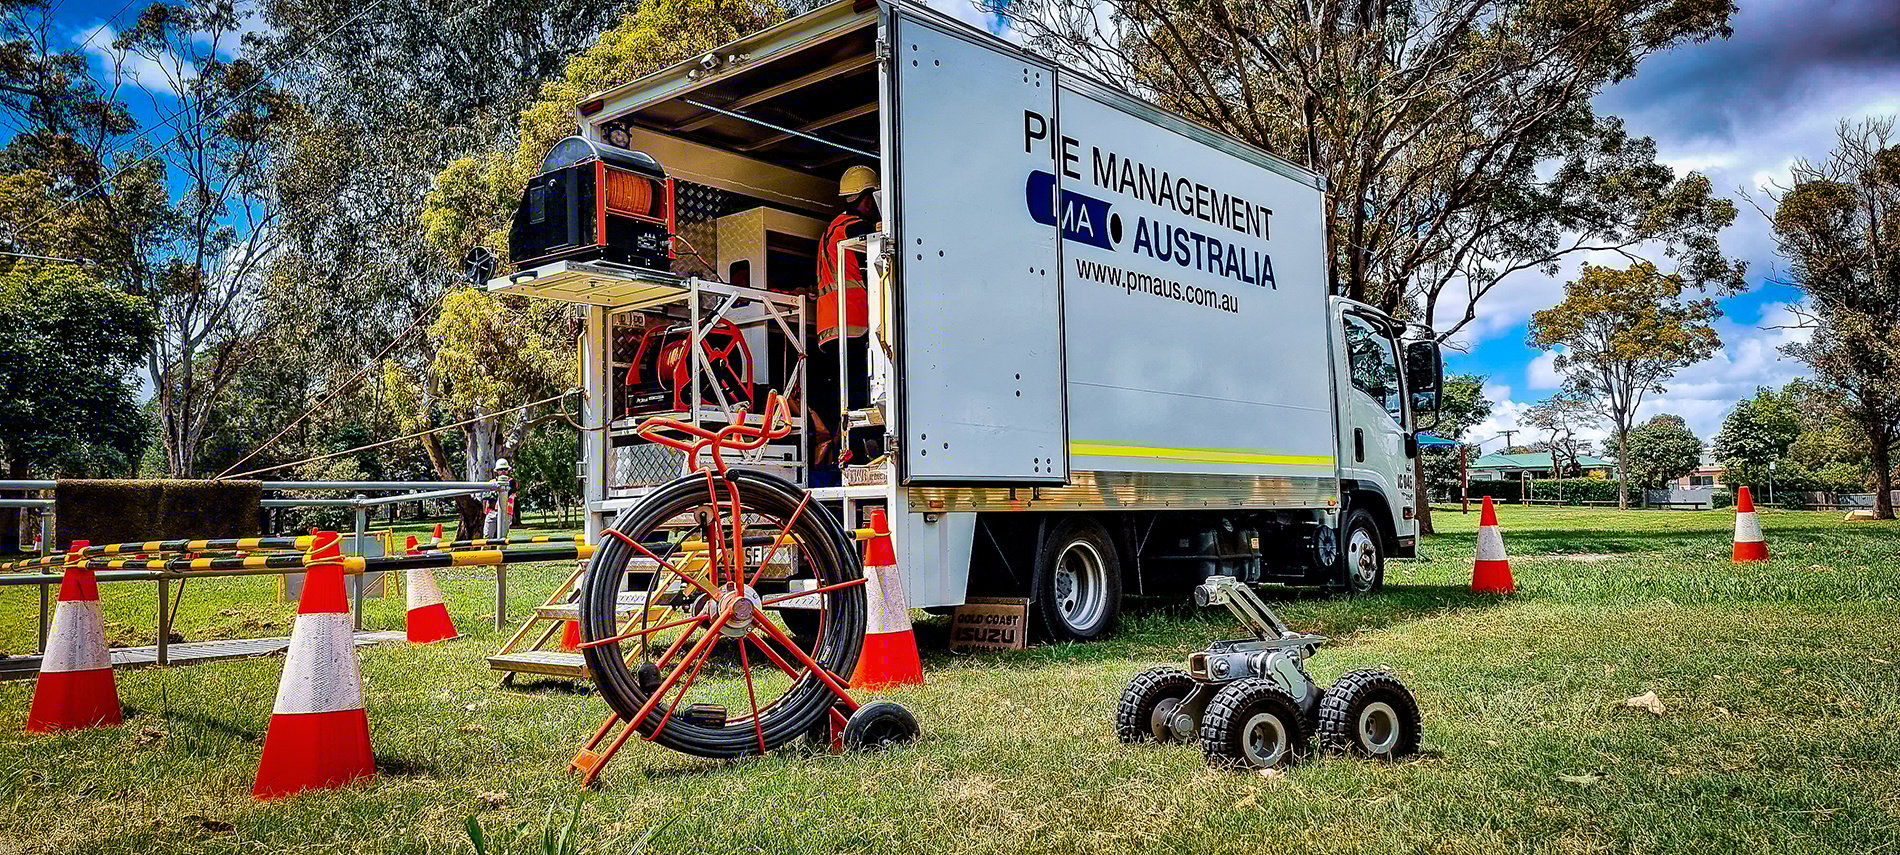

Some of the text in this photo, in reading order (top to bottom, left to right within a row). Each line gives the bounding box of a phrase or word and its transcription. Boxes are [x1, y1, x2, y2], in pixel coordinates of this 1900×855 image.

[1092, 146, 1274, 241] MANAGEMENT
[1133, 216, 1277, 290] AUSTRALIA
[1075, 258, 1239, 313] www.pmaus.com.au
[956, 627, 1015, 643] ISUZU
[957, 613, 1019, 626] GOLD COAST
